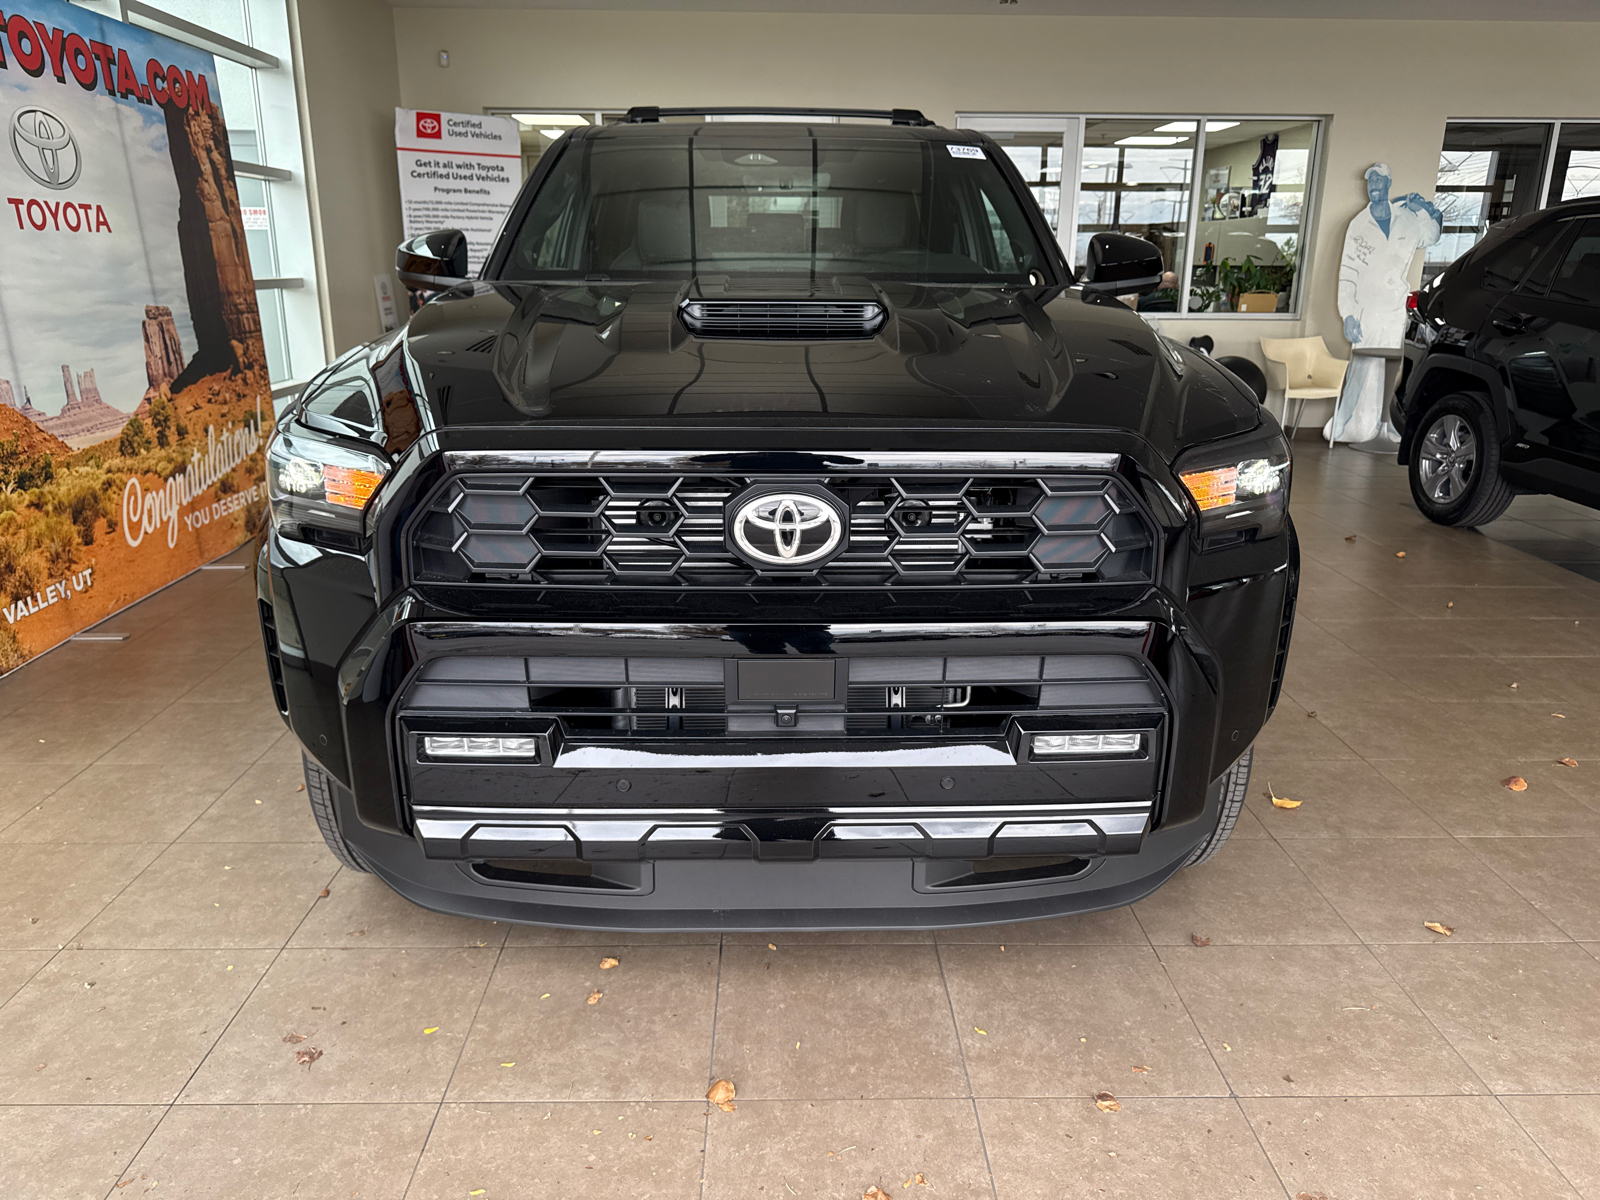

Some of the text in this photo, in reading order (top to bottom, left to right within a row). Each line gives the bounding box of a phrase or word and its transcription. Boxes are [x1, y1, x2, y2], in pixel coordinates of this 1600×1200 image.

[447, 119, 482, 129] Certified
[447, 129, 502, 141] Used Vehicles
[415, 159, 505, 173] Get it all with Toyota
[410, 170, 510, 183] Certified Used Vehicles
[433, 186, 491, 195] Program Benefits
[7, 197, 112, 233] TOYOTA
[123, 395, 263, 549] Congratulations!
[184, 507, 210, 532] YOU
[212, 485, 259, 520] DESERVE
[2, 568, 92, 624] VALLEY, UT
